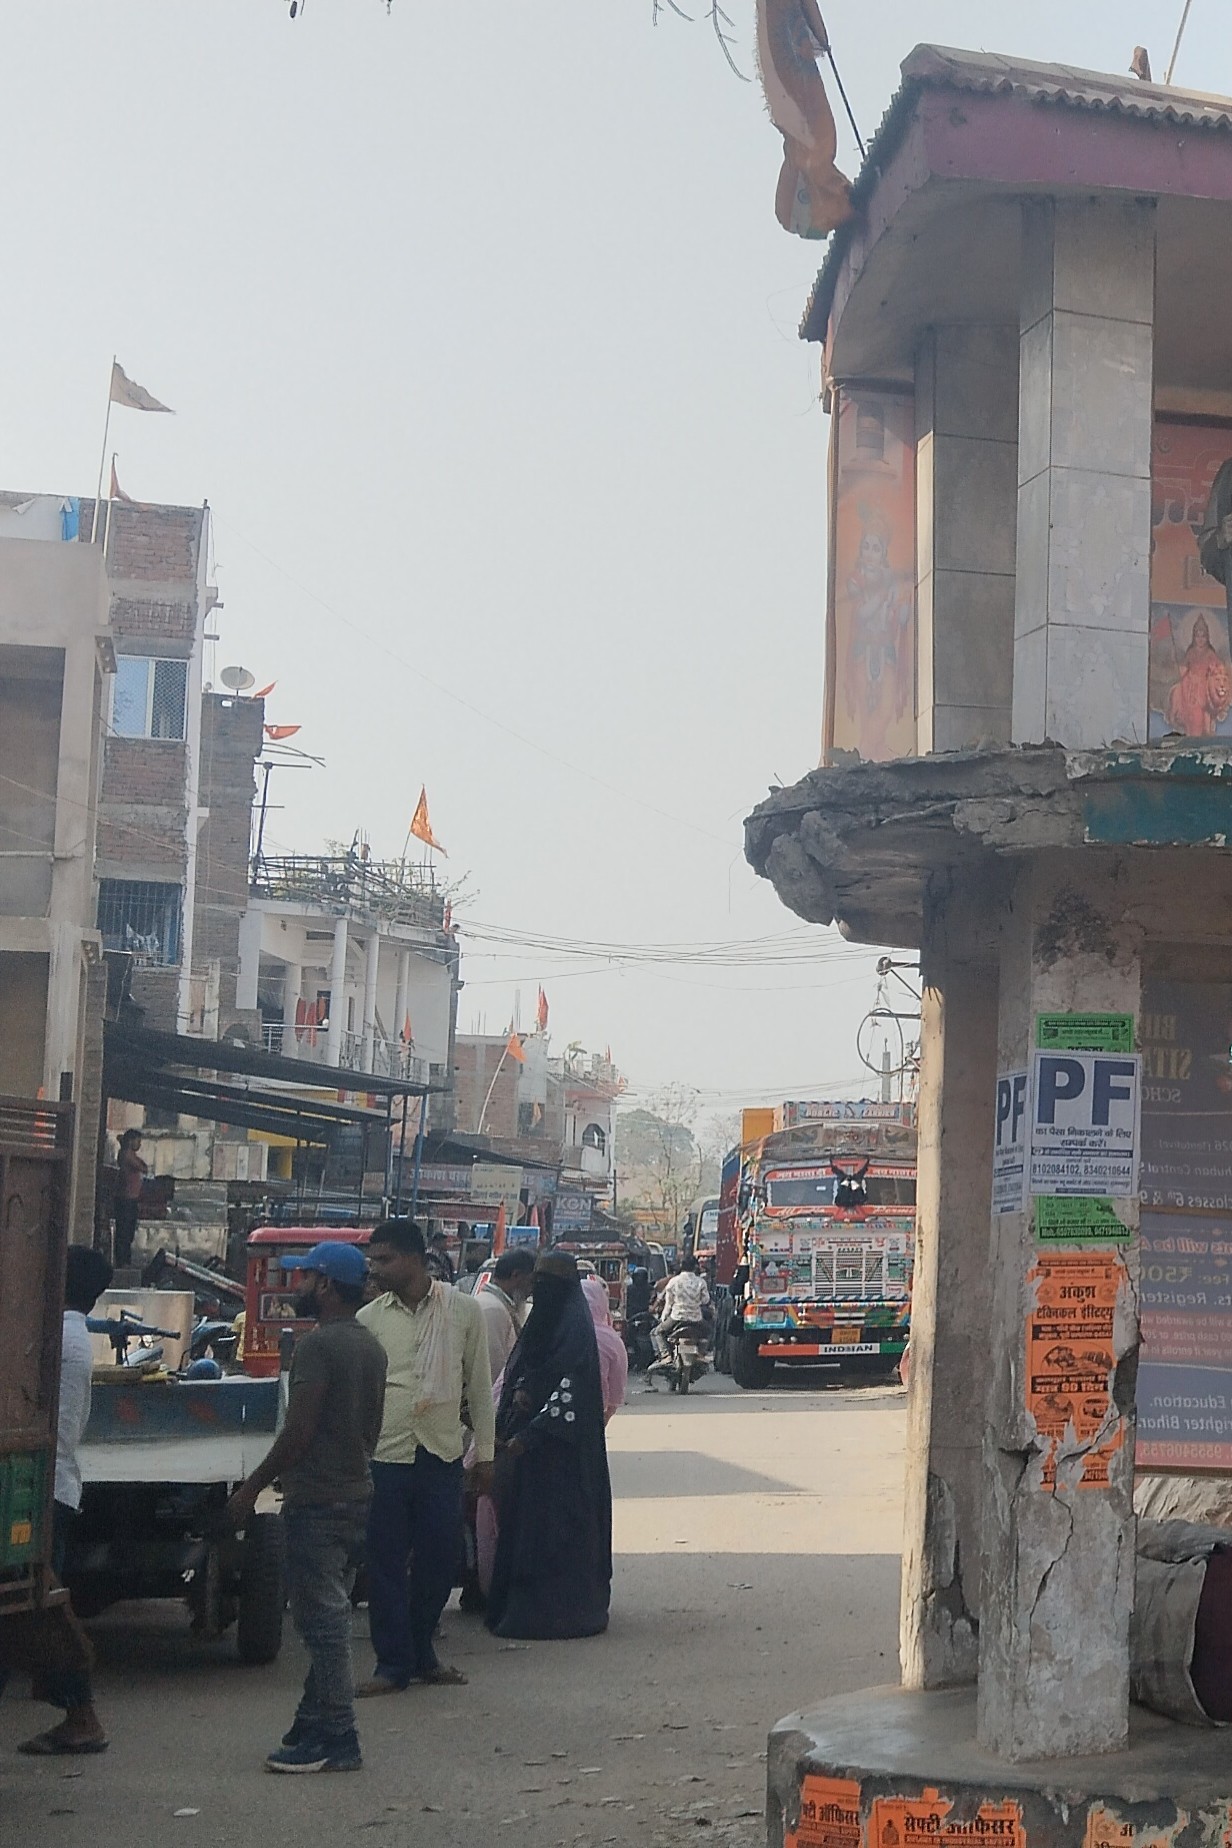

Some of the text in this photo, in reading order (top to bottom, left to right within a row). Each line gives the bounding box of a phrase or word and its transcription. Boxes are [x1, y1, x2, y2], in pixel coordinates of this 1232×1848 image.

[1038, 1058, 1135, 1126] PF
[997, 1075, 1027, 1146] PF
[1048, 1126, 1065, 1136] पैसा
[1067, 1126, 1102, 1136] निकालने
[1105, 1127, 1113, 1136] के
[1115, 1127, 1131, 1138] लिए
[556, 1196, 591, 1210] KGN
[1059, 1281, 1097, 1303] अंकुश
[904, 1812, 941, 1833] सेफ्टी
